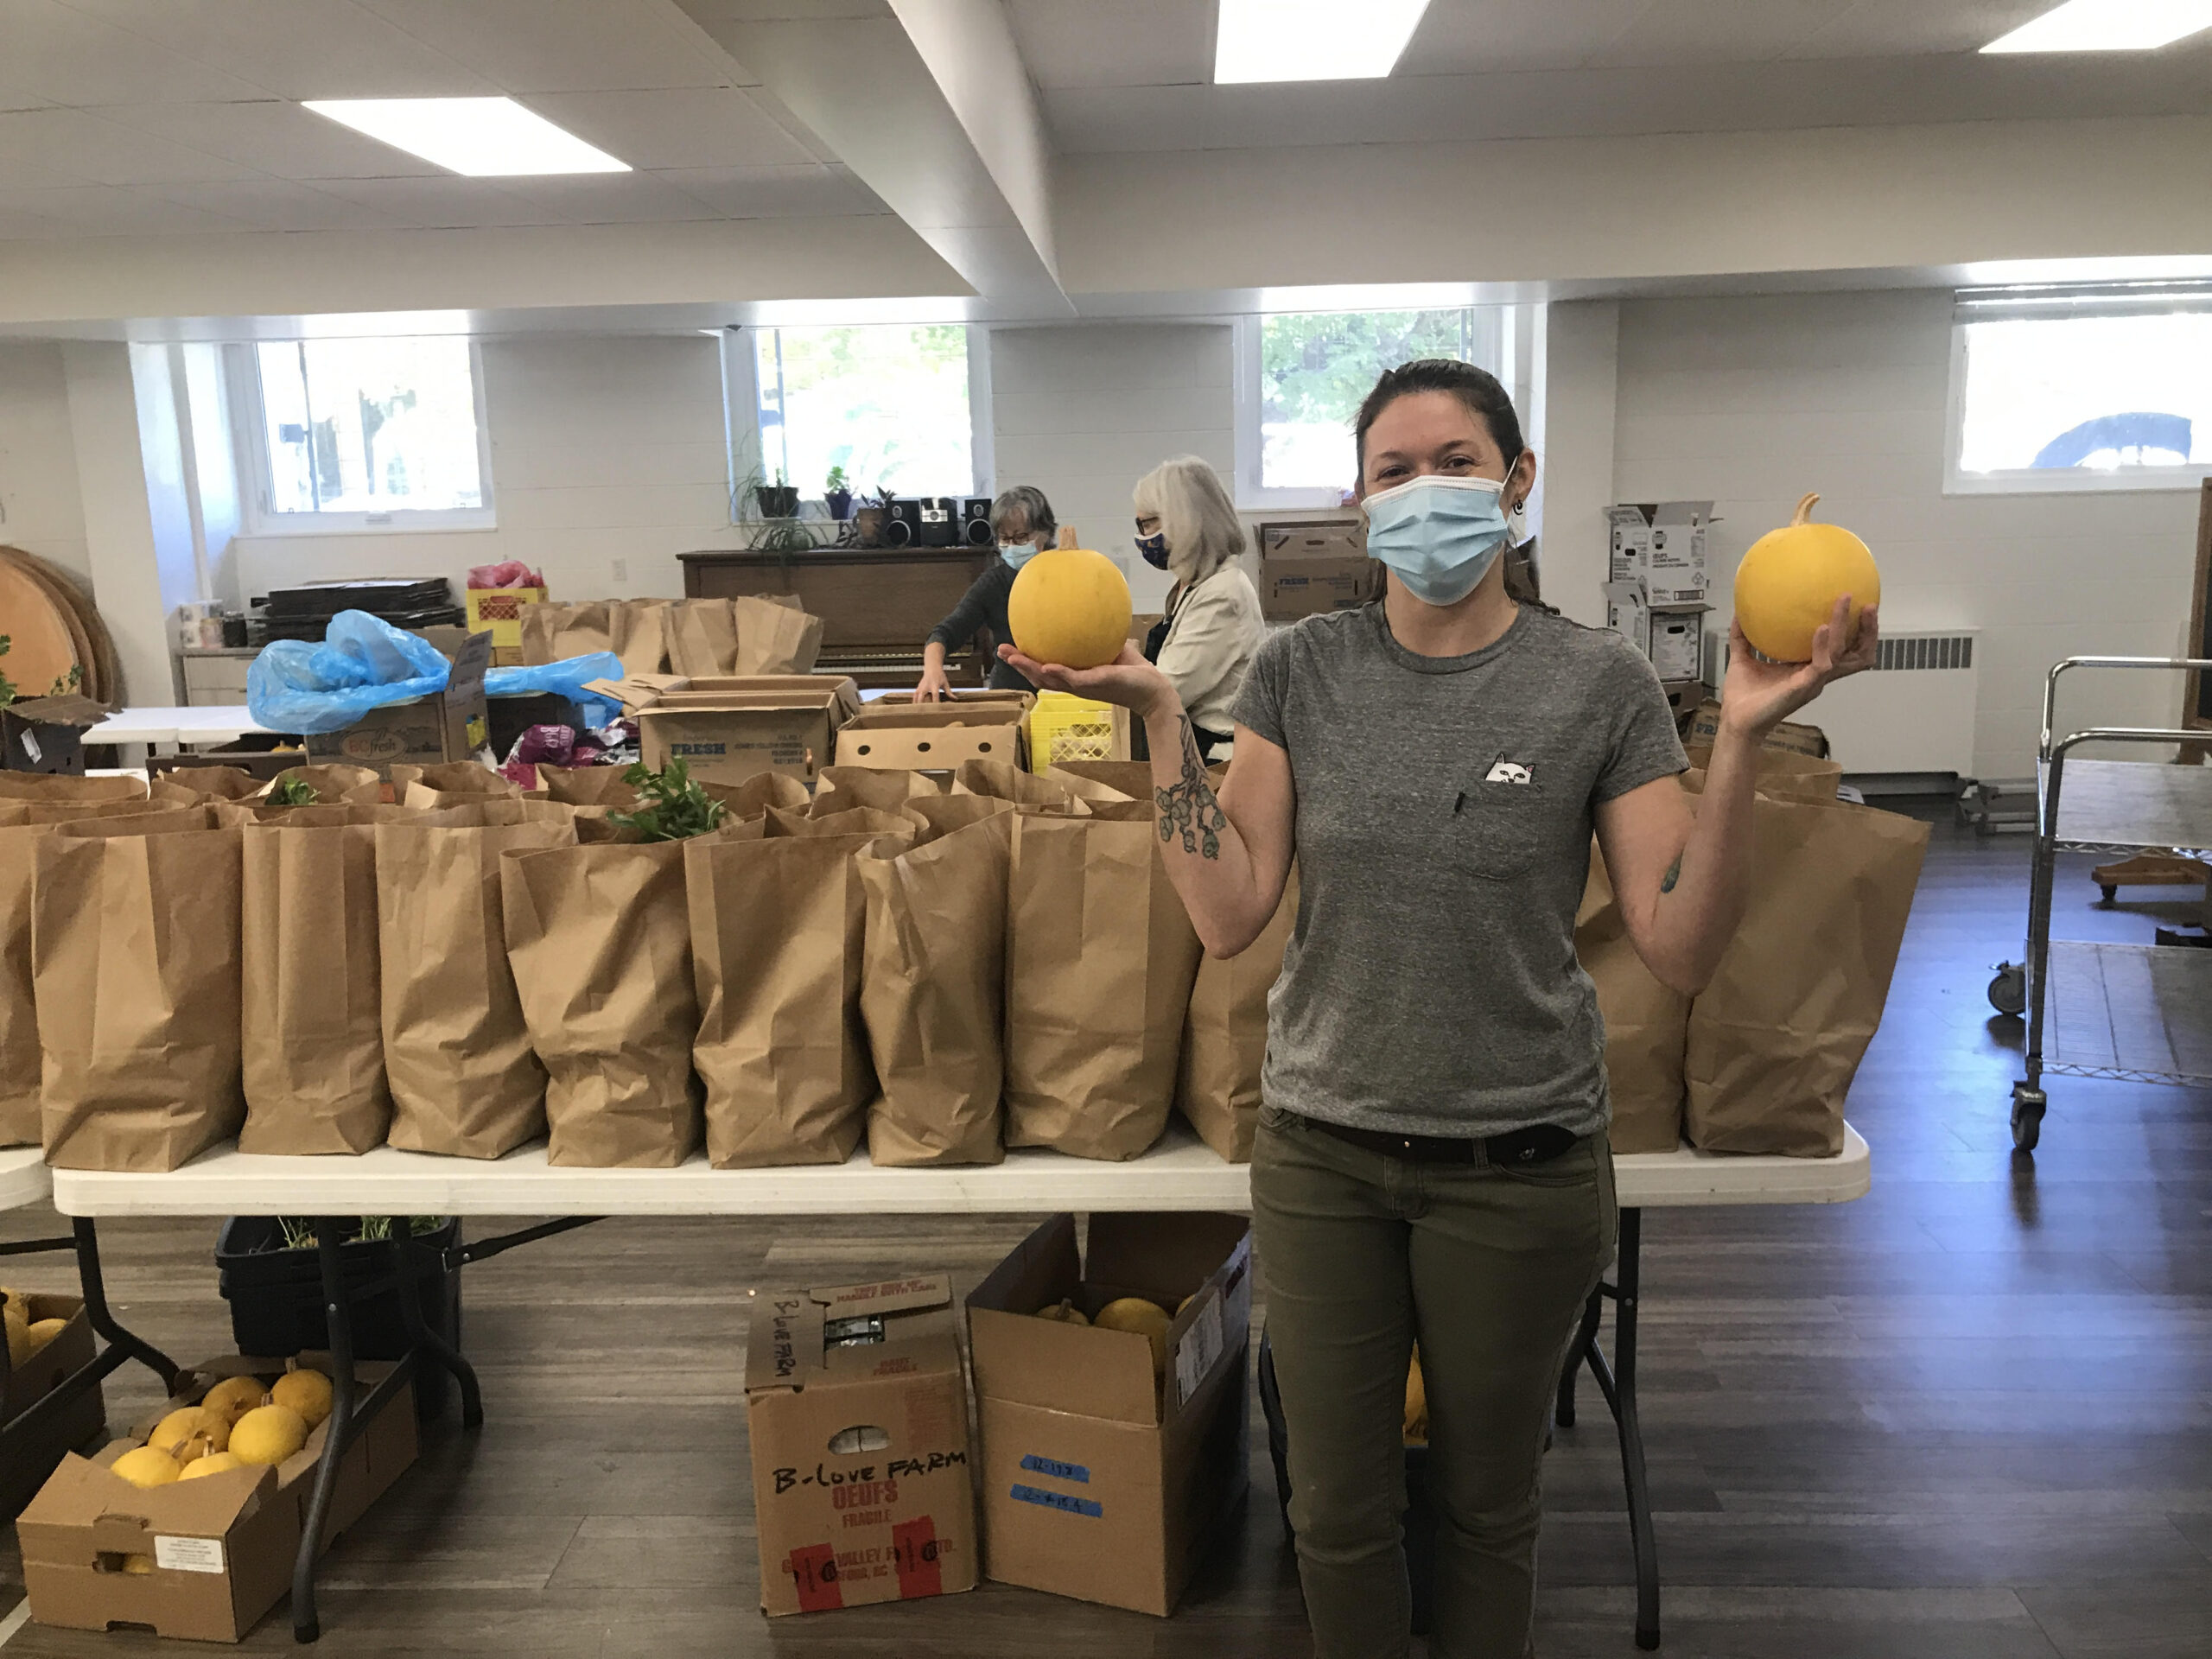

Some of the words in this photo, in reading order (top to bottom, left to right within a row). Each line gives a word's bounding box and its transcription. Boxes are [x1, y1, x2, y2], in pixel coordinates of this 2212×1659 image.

[671, 742, 727, 755] FRESH
[887, 1452, 967, 1479] FARM
[832, 1478, 899, 1510] OEUFS
[842, 1510, 893, 1529] FRAGILE
